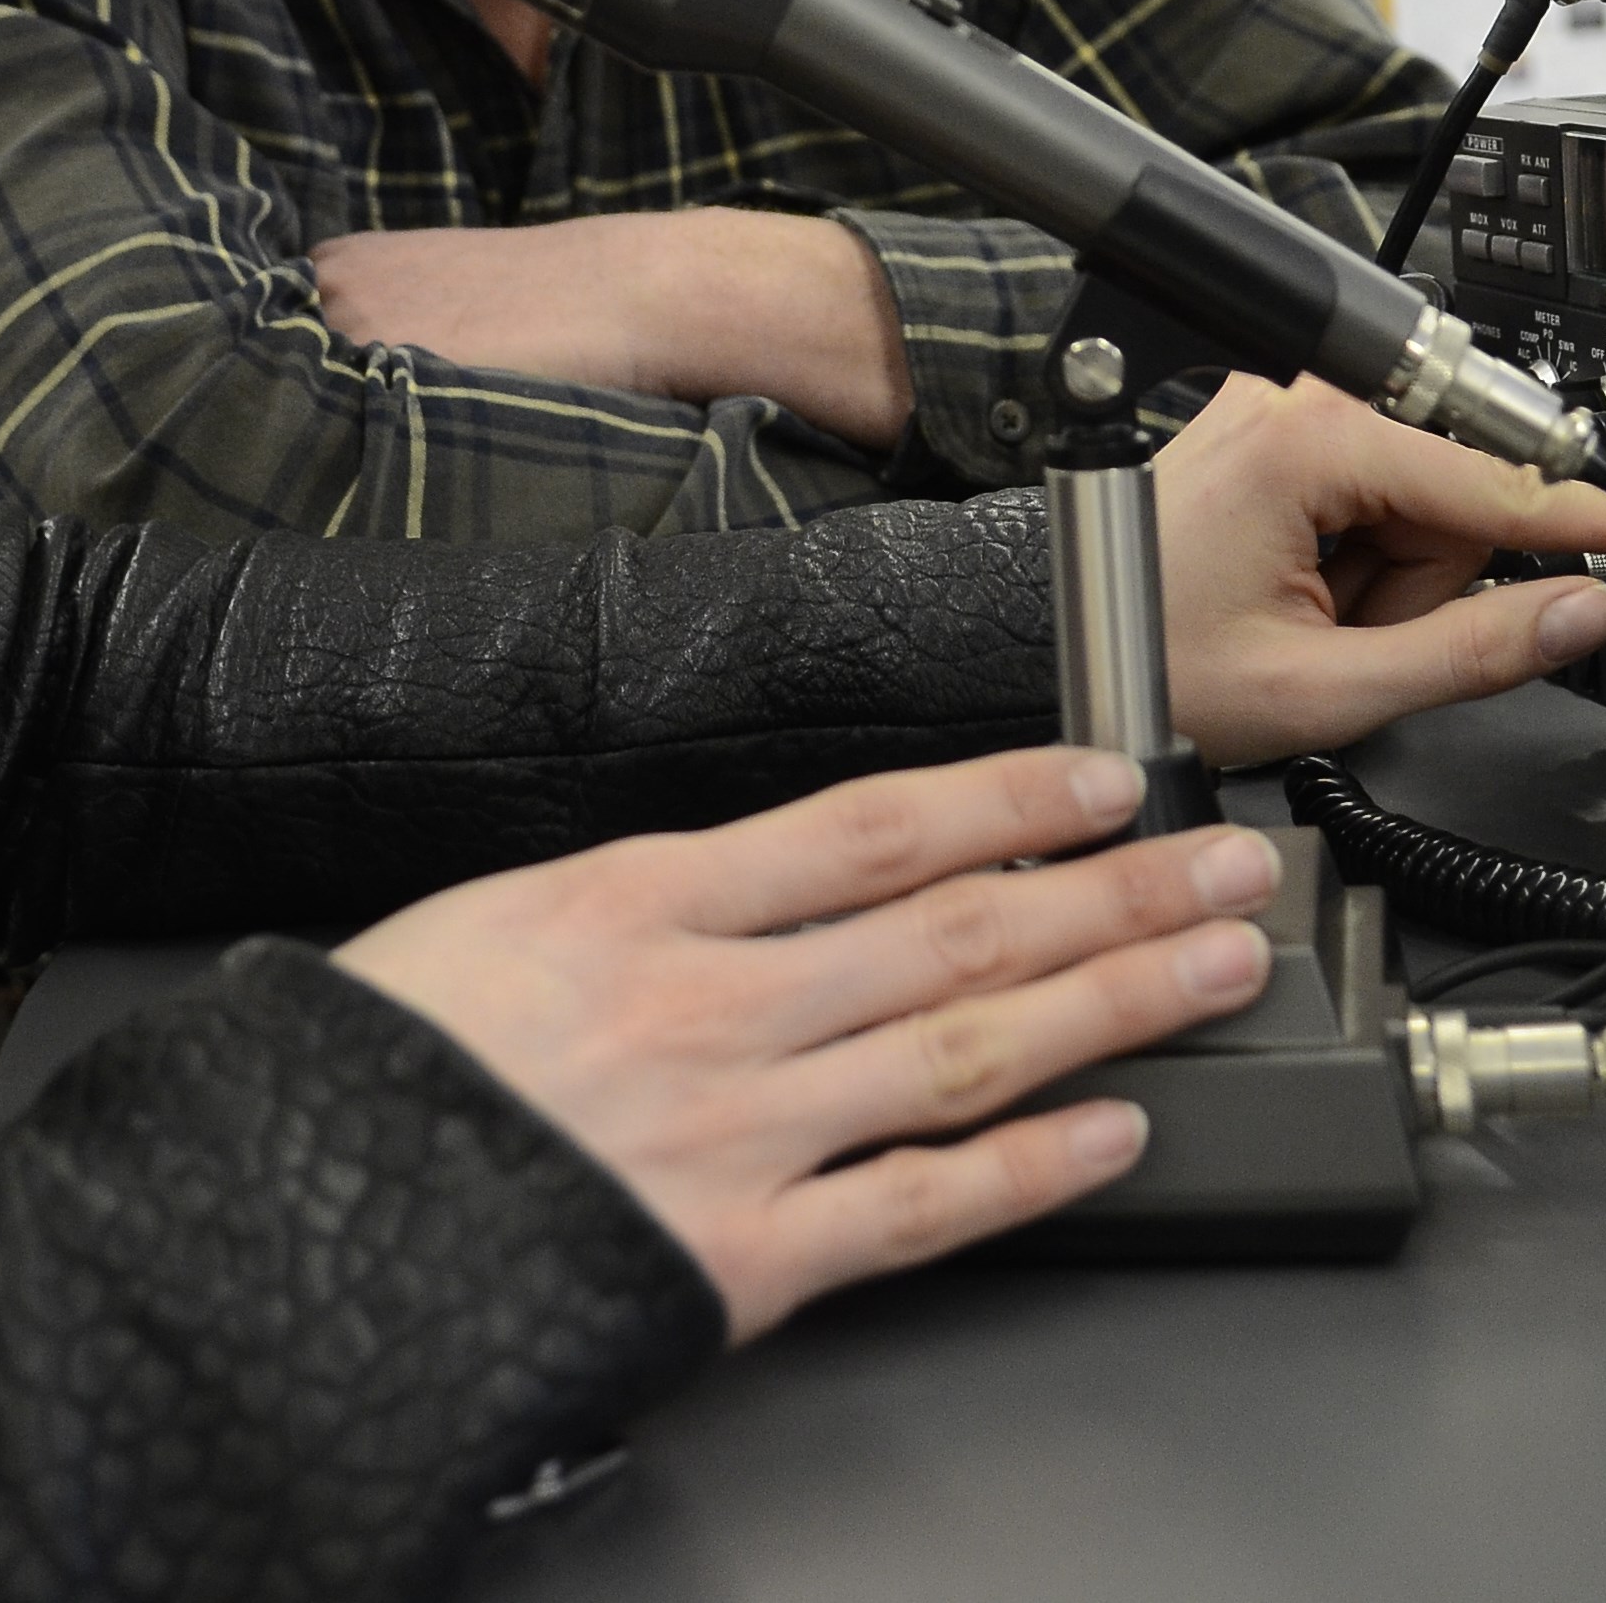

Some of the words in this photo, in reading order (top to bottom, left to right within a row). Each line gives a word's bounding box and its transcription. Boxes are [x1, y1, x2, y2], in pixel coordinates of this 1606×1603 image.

[1467, 136, 1498, 151] POWER
[1520, 154, 1532, 166] RX
[1534, 156, 1550, 168] ANT
[1469, 212, 1489, 226] MOX
[1500, 218, 1518, 231] VOX
[1532, 224, 1547, 236] ATT
[1535, 310, 1561, 326] METER
[1471, 321, 1501, 339] PHONES
[1520, 329, 1540, 344] COMP
[1543, 328, 1554, 340] PO
[1558, 339, 1575, 353] SWR
[1517, 347, 1531, 360] ALC
[1591, 347, 1606, 360] OFF
[1569, 360, 1578, 372] IC
